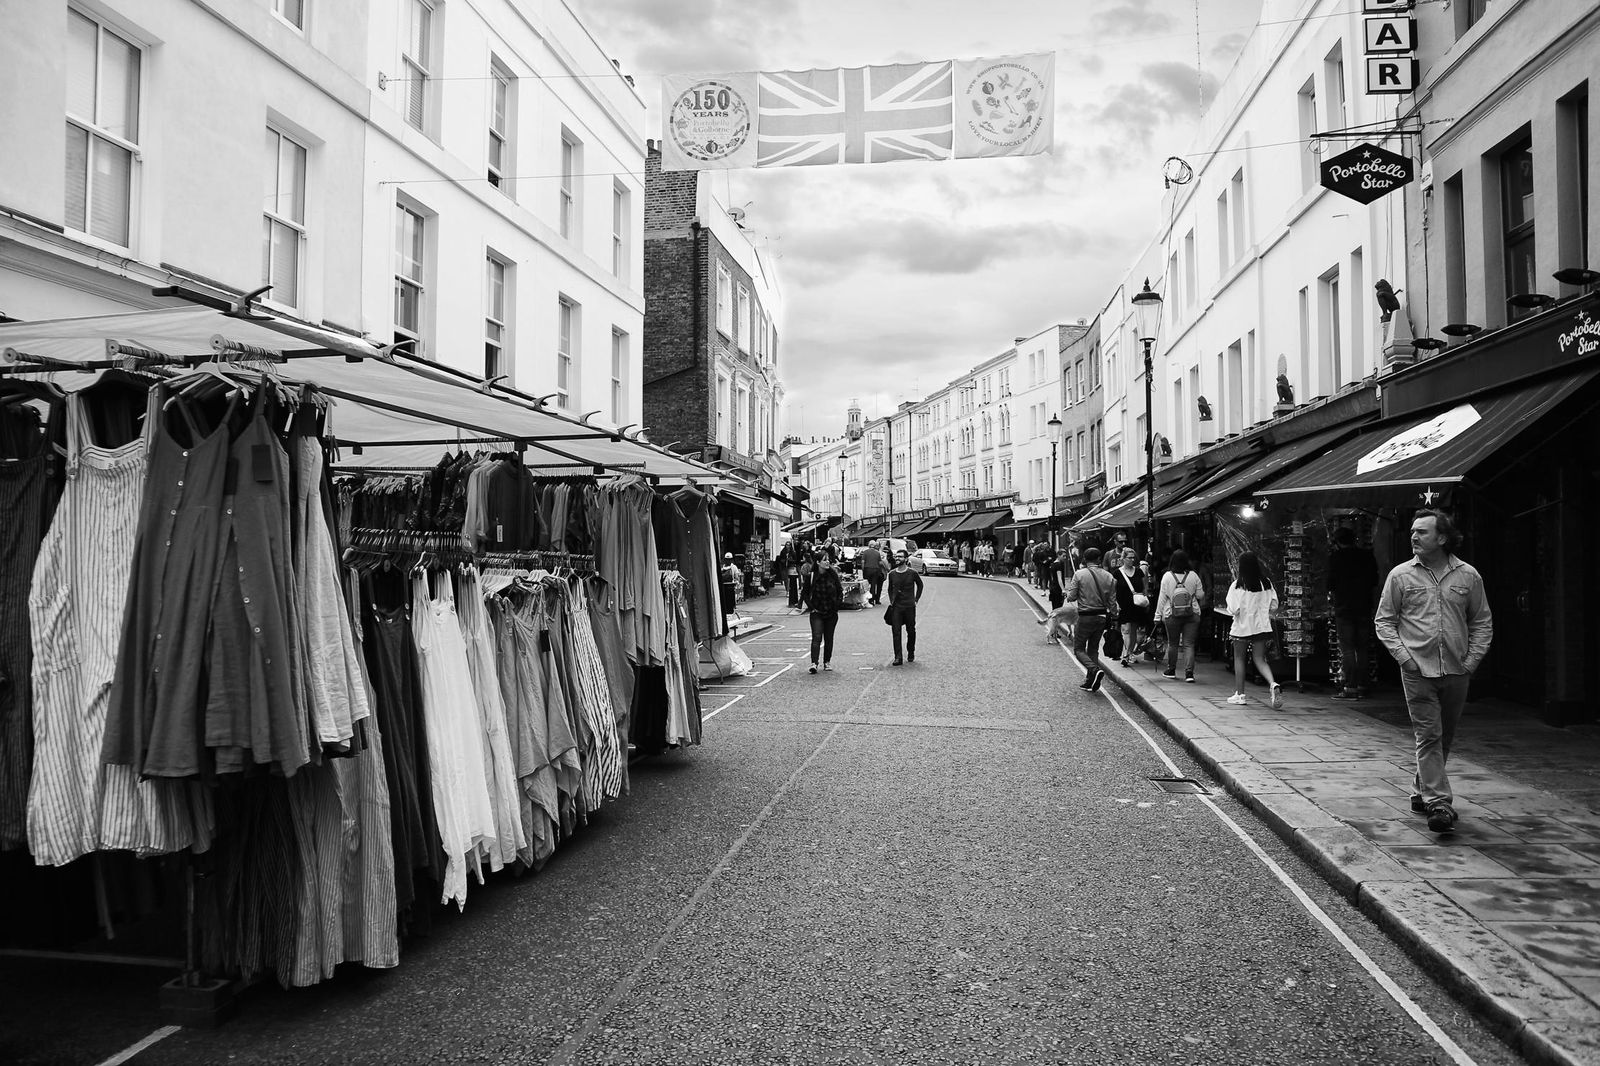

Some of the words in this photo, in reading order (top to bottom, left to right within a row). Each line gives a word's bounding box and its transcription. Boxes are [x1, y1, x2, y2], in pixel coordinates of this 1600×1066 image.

[1376, 0, 1402, 86] AR
[692, 89, 731, 110] 150
[1328, 158, 1406, 183] Portobello
[1361, 173, 1394, 190] Star
[1557, 317, 1600, 353] Portobel
[1577, 336, 1600, 356] Star
